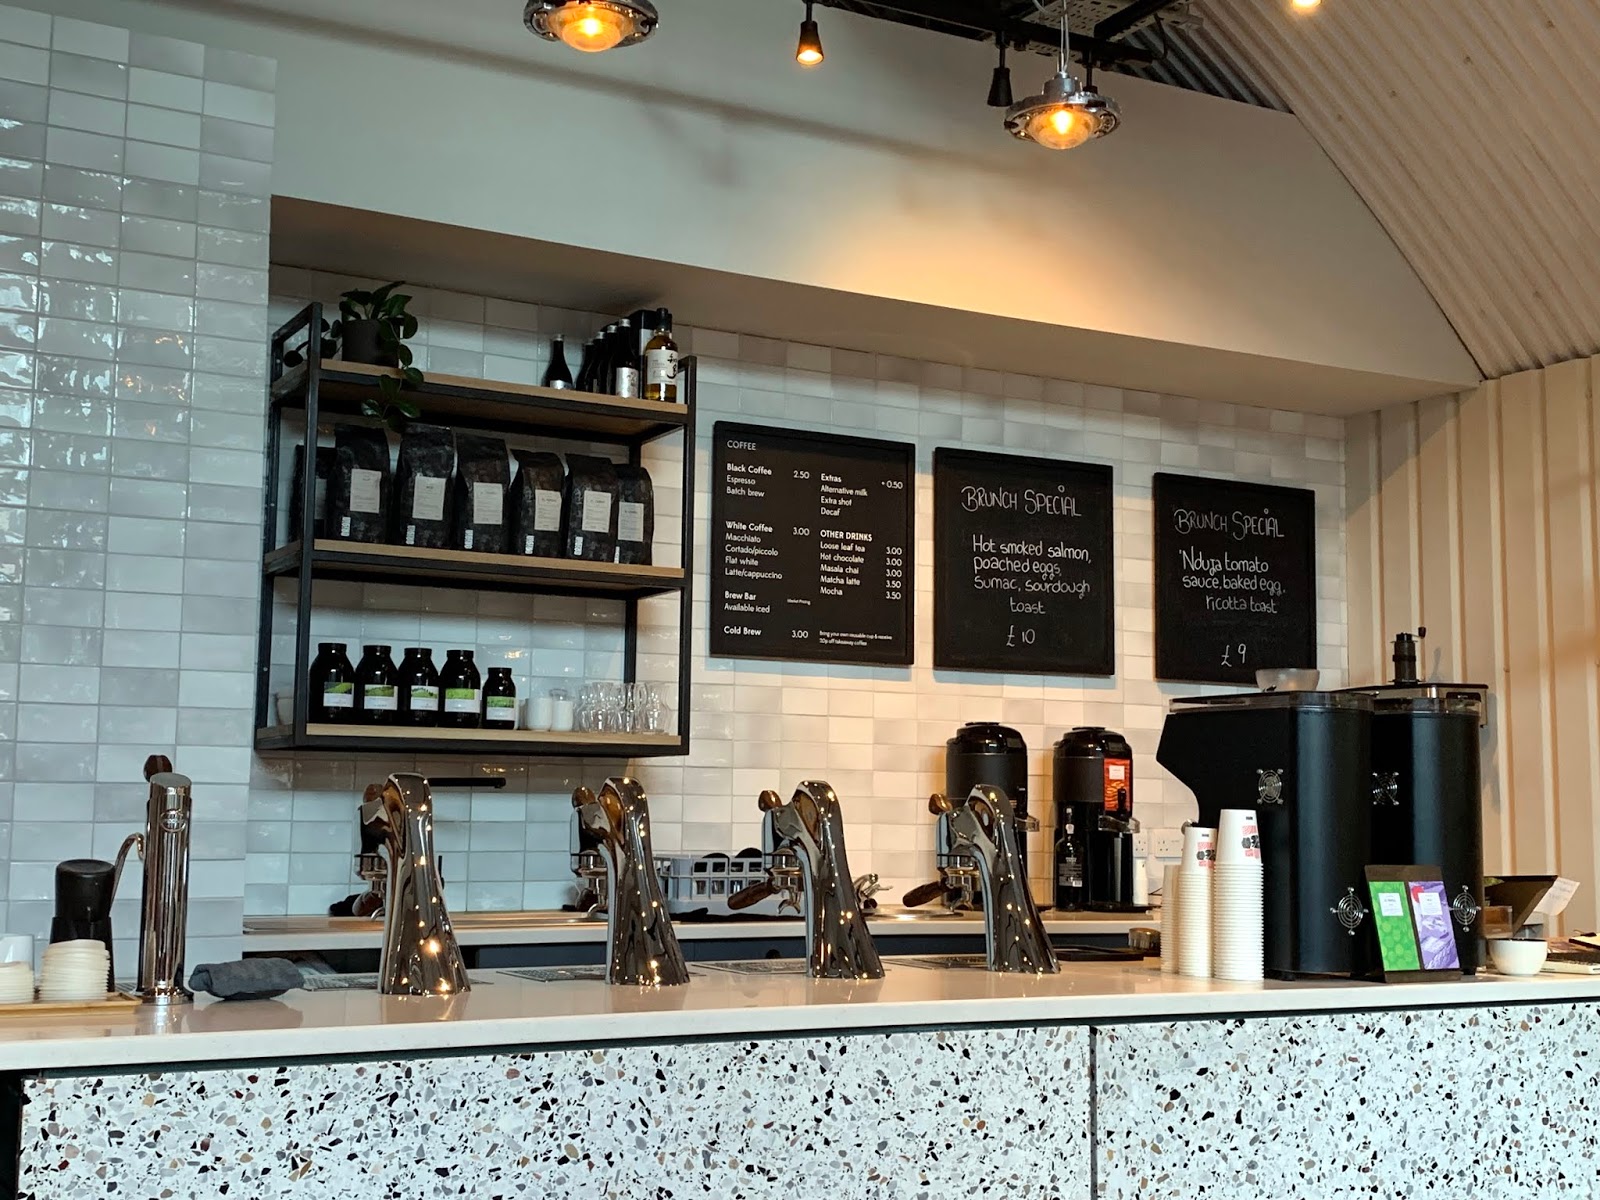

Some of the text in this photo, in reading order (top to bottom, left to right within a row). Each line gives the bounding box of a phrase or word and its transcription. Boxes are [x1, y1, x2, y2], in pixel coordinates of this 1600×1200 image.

[727, 440, 757, 451] COFFEE
[726, 463, 810, 479] Black Coffee 2.50
[726, 475, 756, 486] Espresso
[821, 473, 842, 483] Extras
[726, 487, 764, 497] Batch brew
[820, 485, 868, 497] Alternative milk
[820, 496, 852, 506] Extra shot
[961, 485, 1082, 517] BRUNCH SPECIAL
[820, 507, 840, 516] Decaf
[726, 521, 809, 536] White Coffee 3.00
[1174, 508, 1284, 540] BRUNCH SPECIAL
[726, 532, 761, 543] Macchiato
[820, 530, 873, 542] OTHER DRINKS
[725, 544, 779, 556] Cortado/piccolo
[820, 542, 839, 550] Loose
[841, 543, 853, 551] leaf
[886, 547, 902, 555] 3.00
[973, 534, 1091, 563] Hot smoked salmon,
[725, 556, 758, 566] Flat white
[820, 553, 902, 566] Hot chocolate 3.00
[973, 556, 1030, 574] poached
[1225, 551, 1269, 573] tomato
[725, 568, 782, 579] Latte/cappuccino
[820, 564, 902, 577] Masala chai 3.00
[820, 575, 901, 589] Matcha latte 3.50
[1223, 574, 1257, 590] baked
[725, 591, 756, 600] Brew Bar
[820, 587, 901, 600] Mocha 3.50
[724, 603, 755, 612] Available
[1010, 596, 1046, 614] toast
[1206, 595, 1278, 613] ricotta toast
[724, 626, 762, 635] Cold Brew
[791, 630, 808, 639] 3.00
